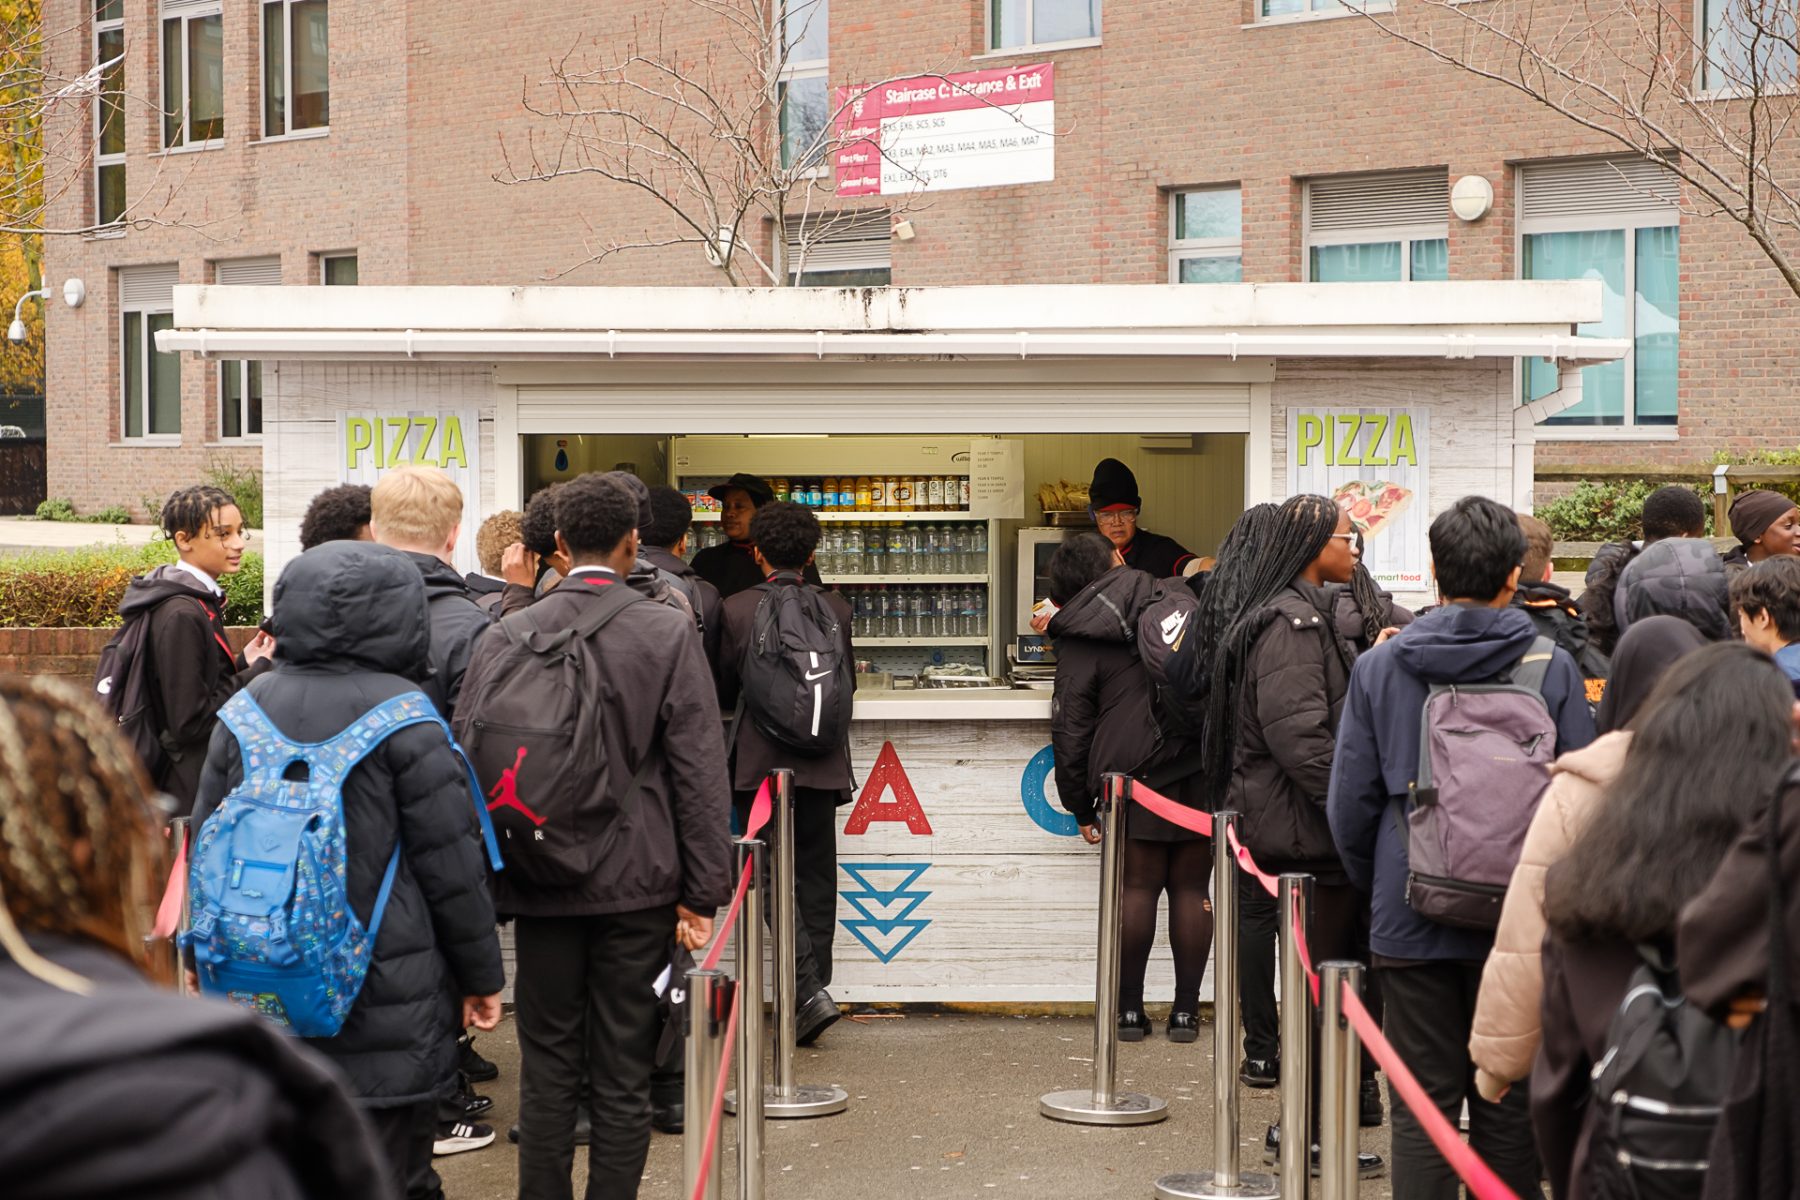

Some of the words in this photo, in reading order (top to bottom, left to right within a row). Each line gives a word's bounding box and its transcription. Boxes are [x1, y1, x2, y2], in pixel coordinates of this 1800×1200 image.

[886, 87, 936, 104] Staircase
[938, 83, 950, 98] C:
[1005, 75, 1016, 90] &
[1018, 72, 1042, 89] Exit
[347, 416, 467, 469] PIZZA
[1297, 413, 1417, 467] PIZZA
[1400, 573, 1421, 581] food
